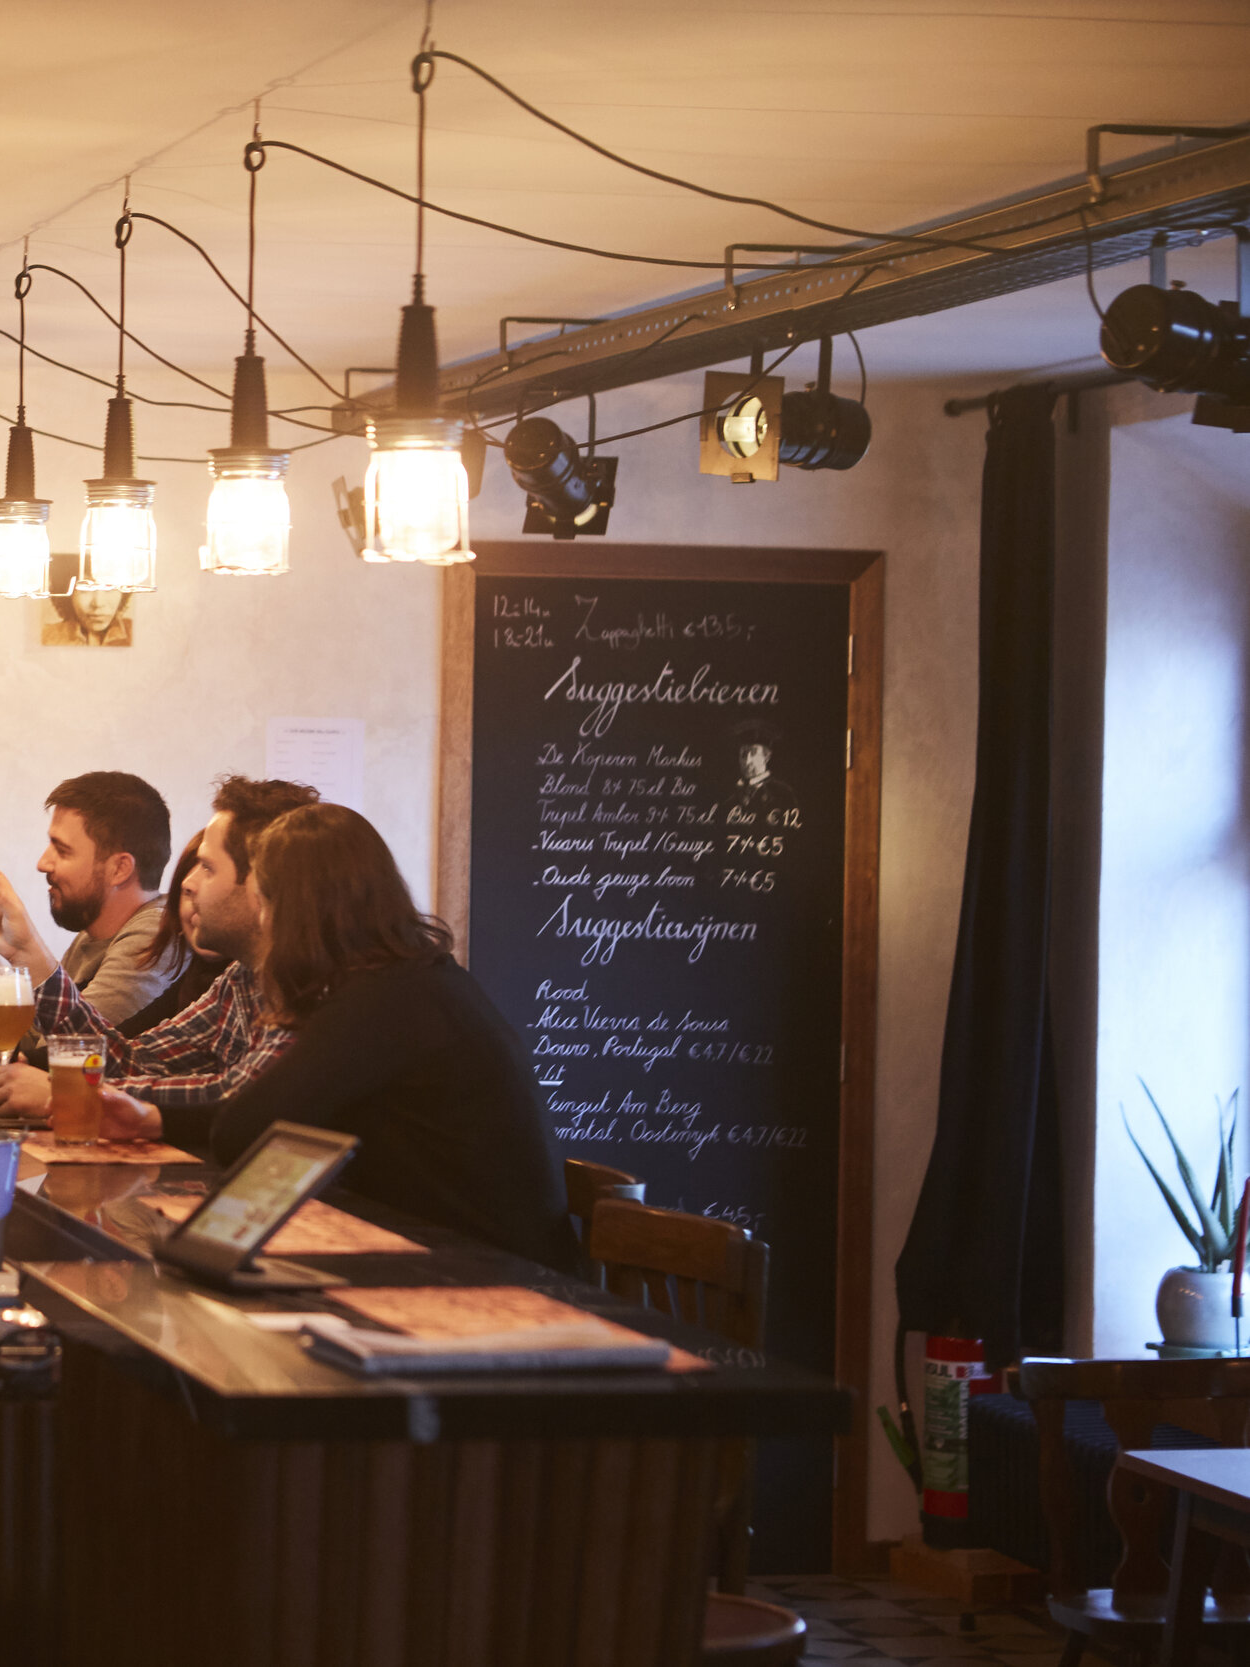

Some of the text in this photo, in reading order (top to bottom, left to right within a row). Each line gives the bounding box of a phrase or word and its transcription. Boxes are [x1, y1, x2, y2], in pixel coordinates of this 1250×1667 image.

[544, 655, 779, 738] Suggestiebieren
[536, 743, 564, 766] De
[539, 773, 591, 796] Blond
[669, 775, 698, 796] Bio
[537, 799, 588, 829] Tripel
[591, 801, 639, 824] Amber
[726, 805, 756, 825] Bio
[536, 893, 758, 967] Suggestiewijnen
[534, 978, 590, 1001] Rood
[646, 1010, 670, 1031] de
[600, 1034, 683, 1073] Portugal
[615, 1089, 649, 1115] Am
[654, 1087, 703, 1128] Berg
